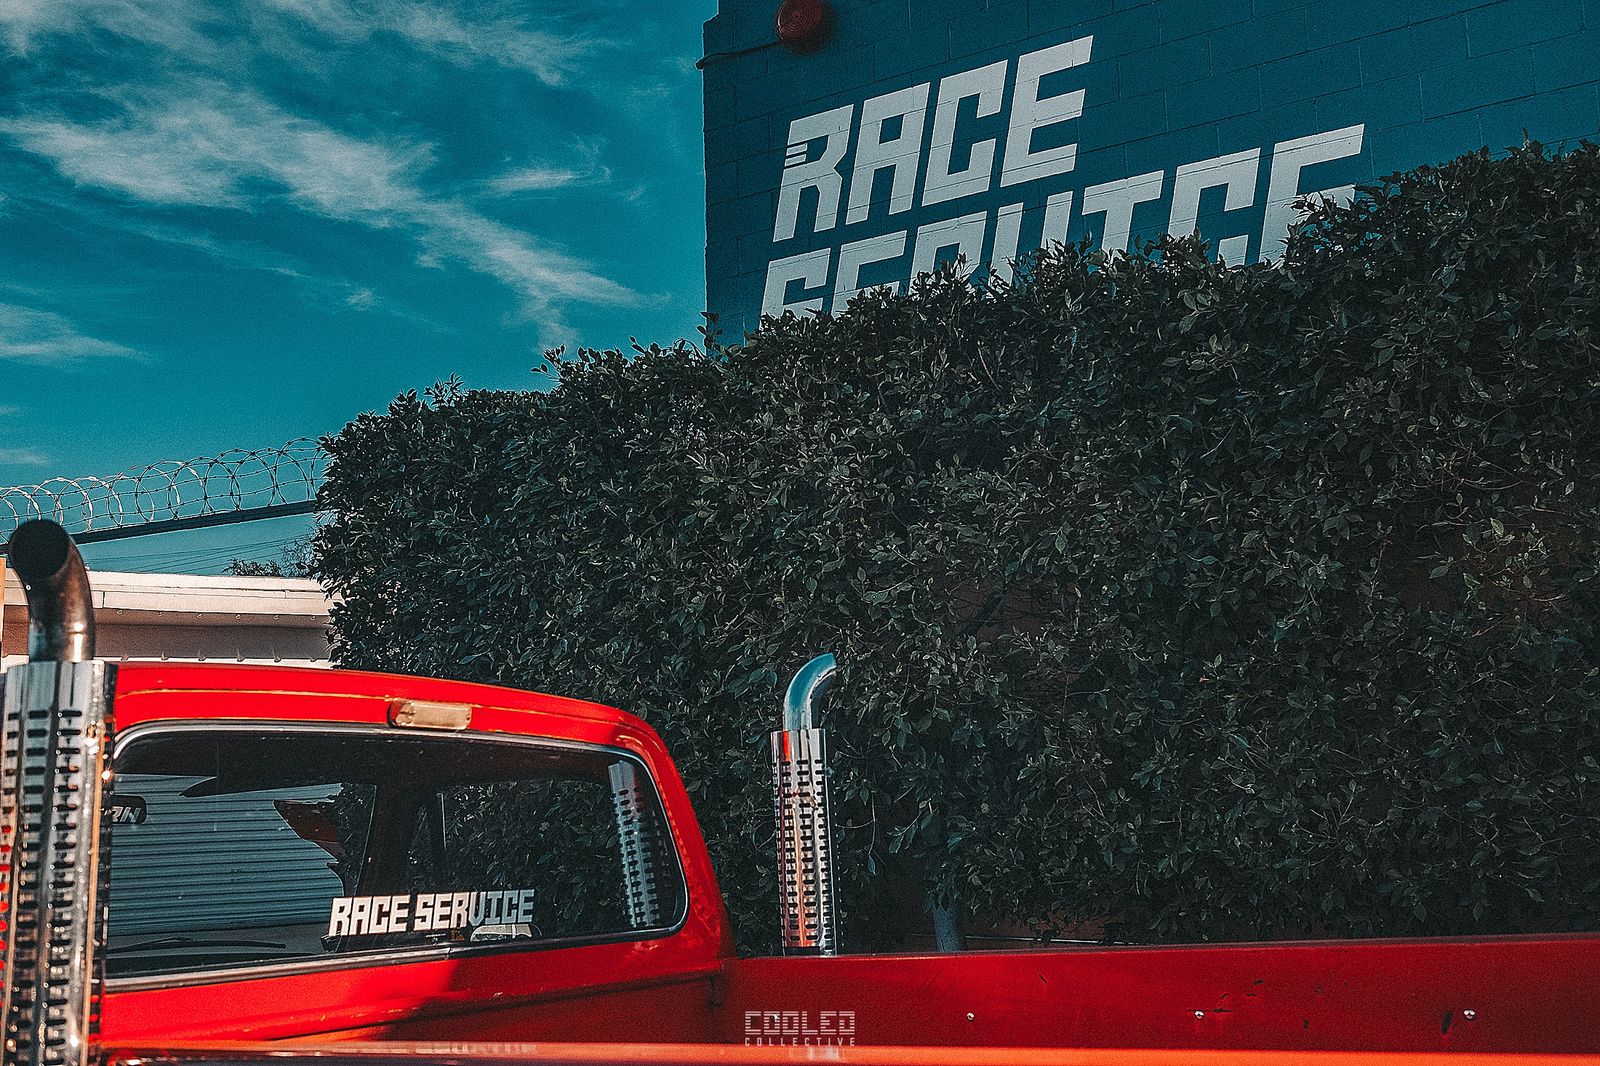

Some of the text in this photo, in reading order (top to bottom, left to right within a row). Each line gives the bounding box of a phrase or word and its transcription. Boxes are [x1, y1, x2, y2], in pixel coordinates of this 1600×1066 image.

[773, 35, 1093, 242] RACE
[329, 889, 535, 937] RACE SERVICE
